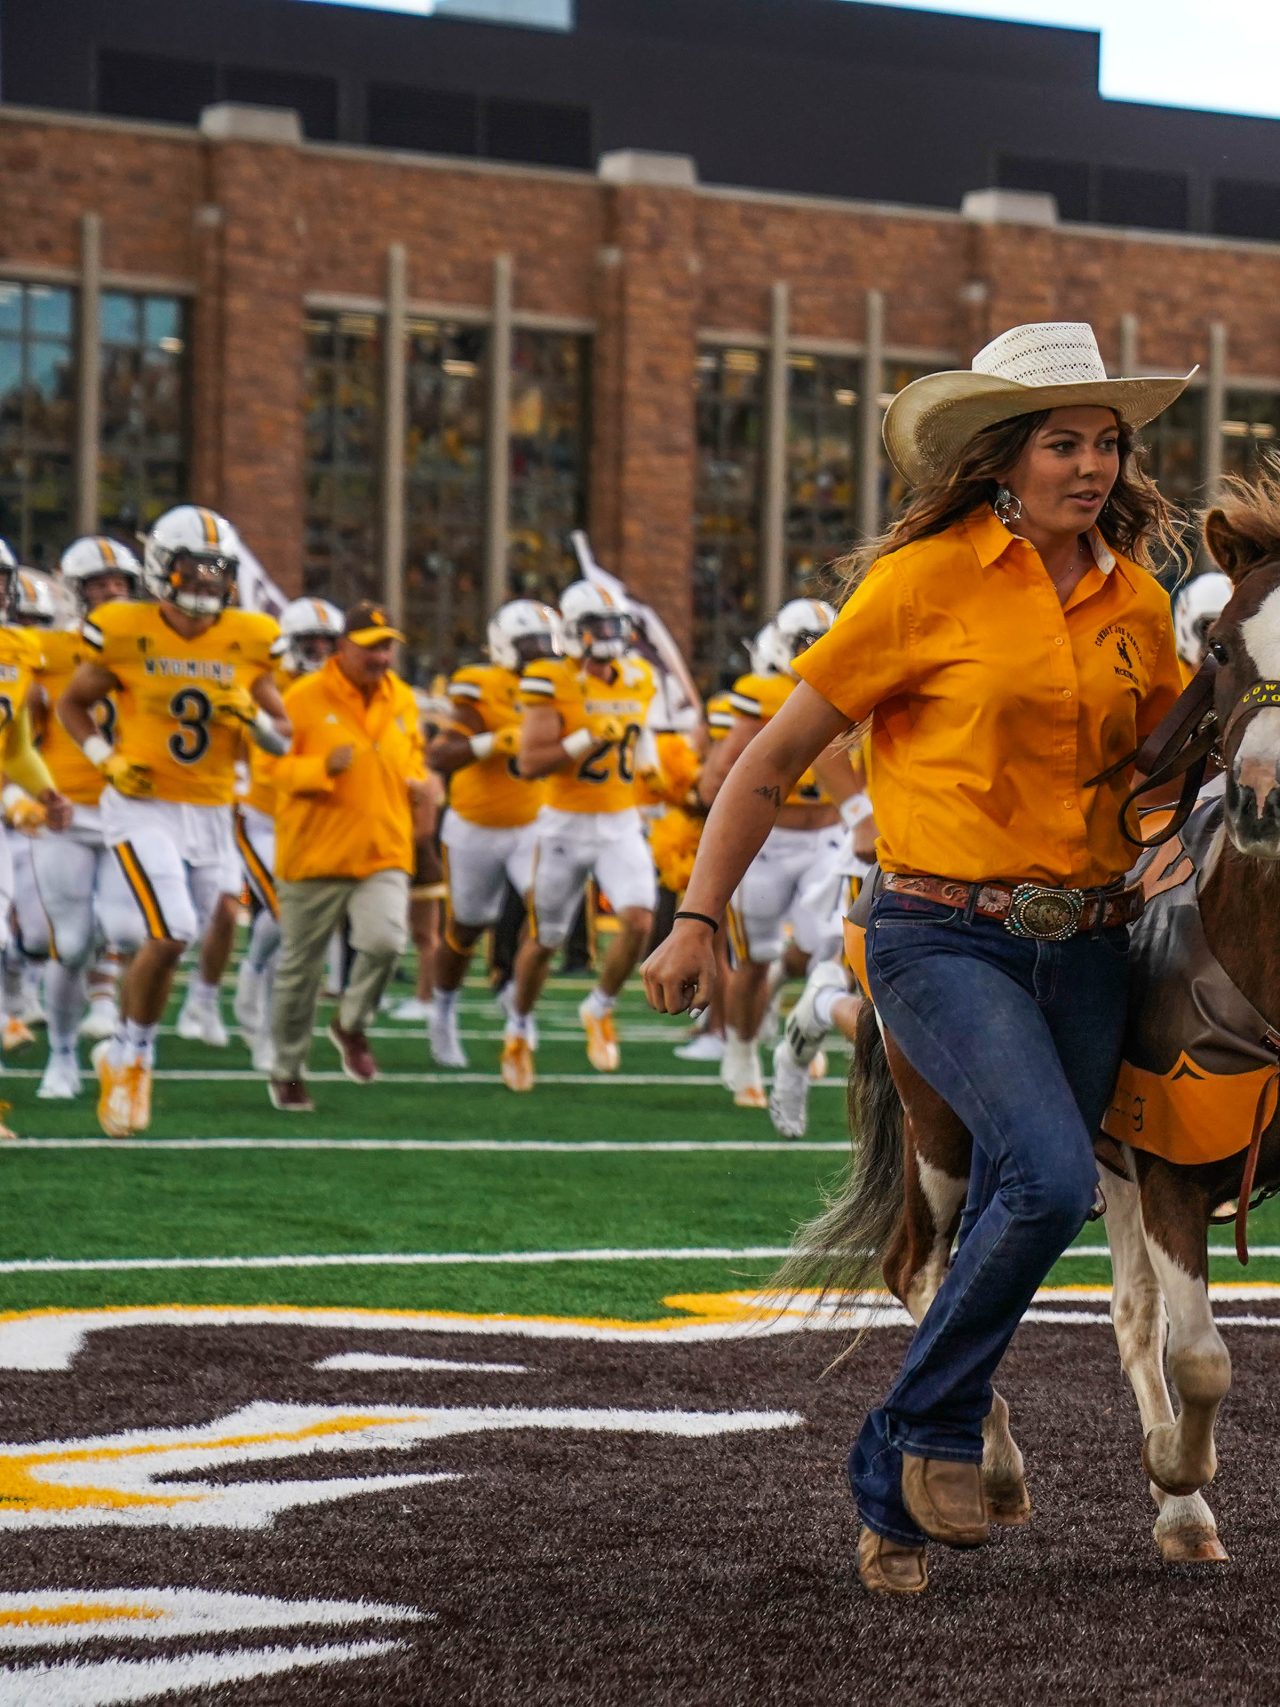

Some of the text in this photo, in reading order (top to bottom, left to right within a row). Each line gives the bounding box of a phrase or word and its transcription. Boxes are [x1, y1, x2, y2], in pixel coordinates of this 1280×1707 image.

[1094, 624, 1114, 647] COWBOY
[145, 658, 234, 683] WYOMING
[168, 685, 212, 764] 3
